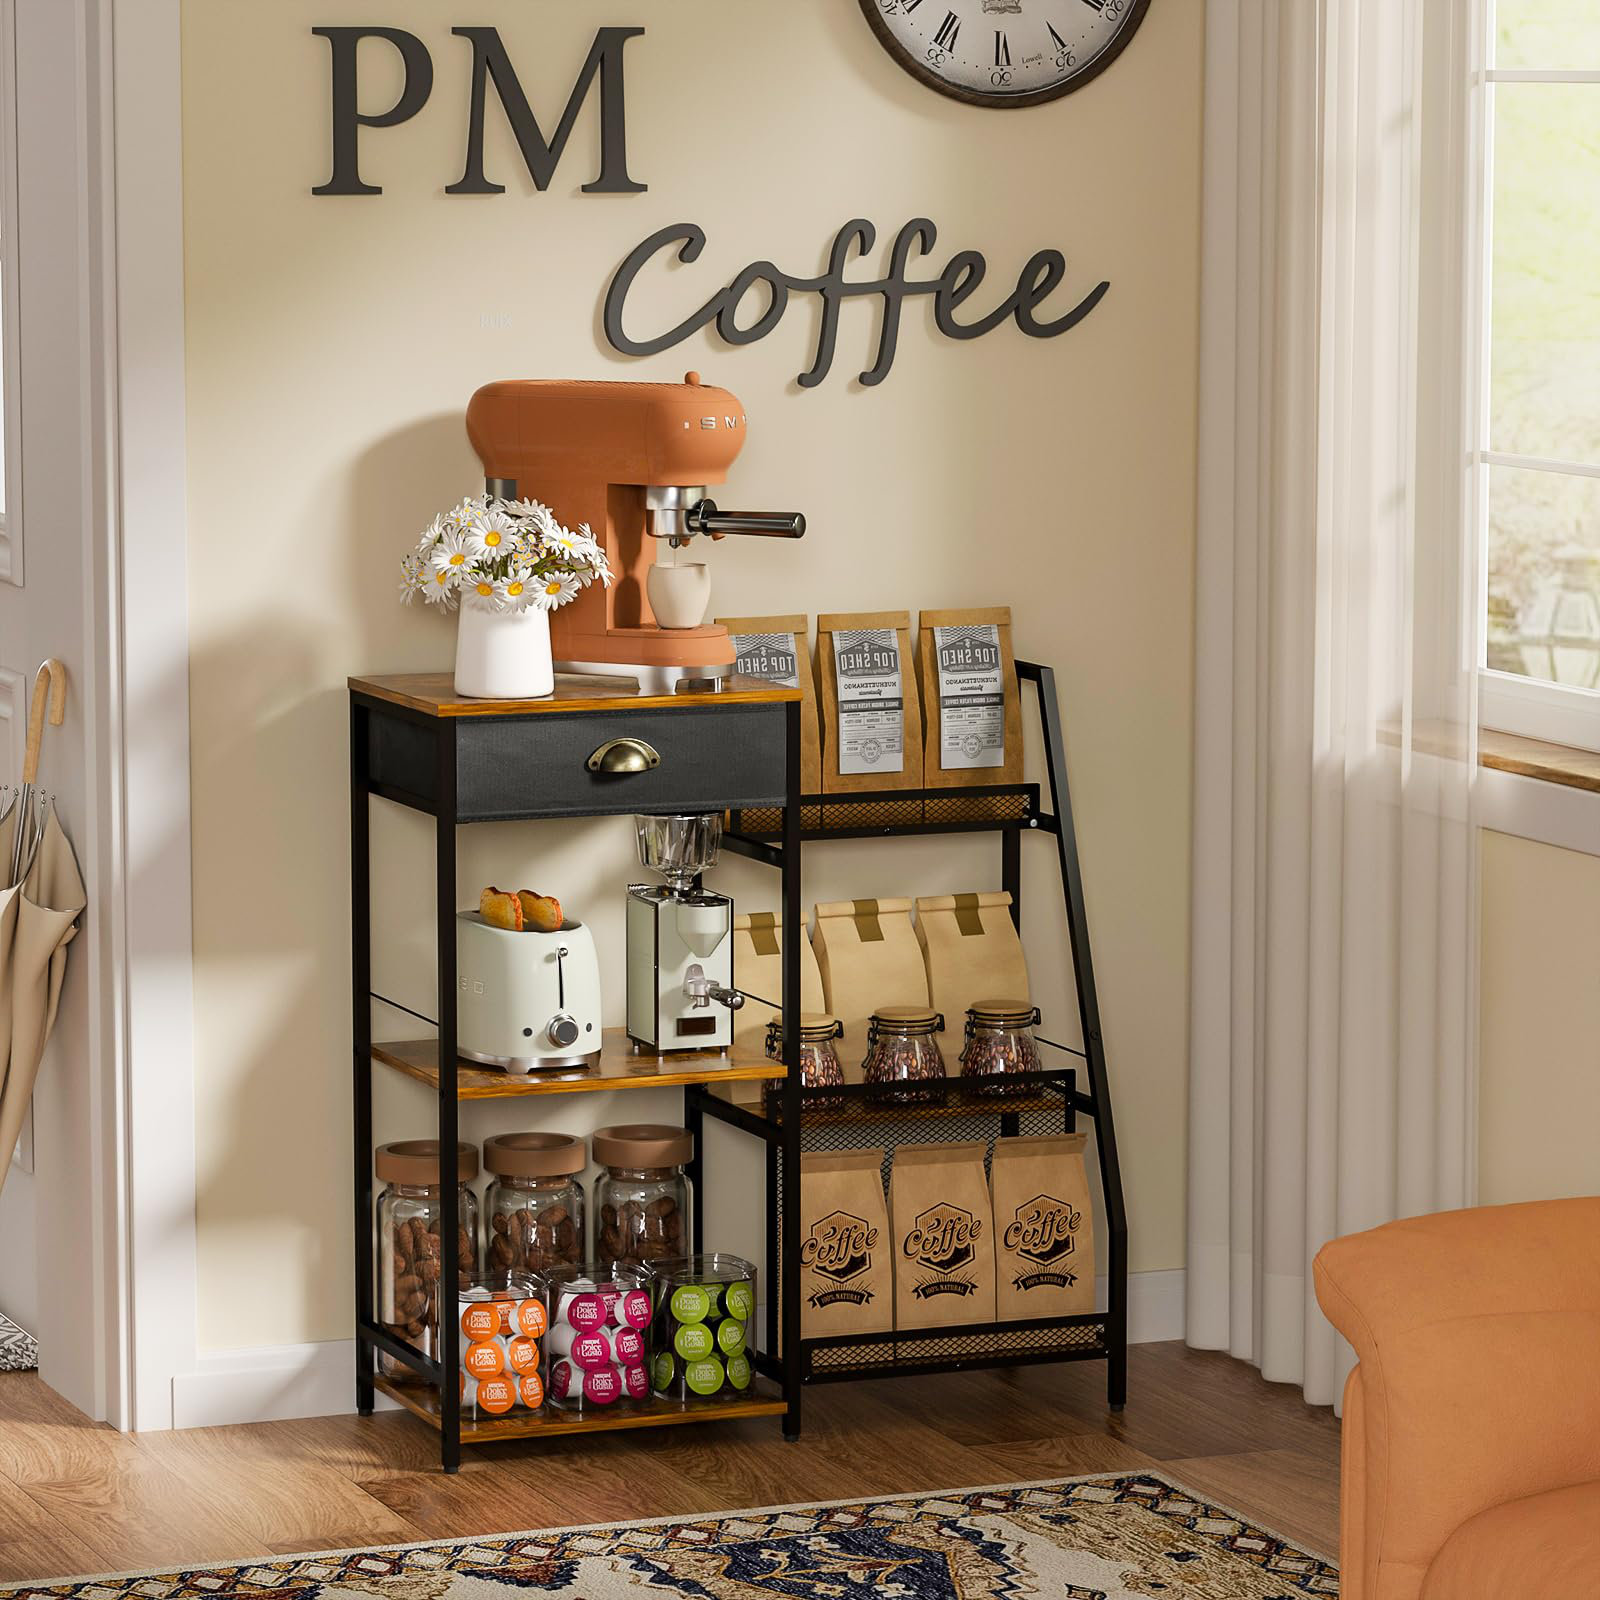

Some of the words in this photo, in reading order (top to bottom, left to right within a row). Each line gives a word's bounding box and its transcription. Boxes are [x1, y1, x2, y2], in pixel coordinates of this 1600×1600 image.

[1022, 53, 1043, 64] Lowell
[312, 27, 648, 195] PM
[604, 217, 1110, 388] Coffee
[800, 1225, 879, 1267] Coffee
[903, 1216, 982, 1259] Coffee
[1003, 1208, 1081, 1251] Coffee
